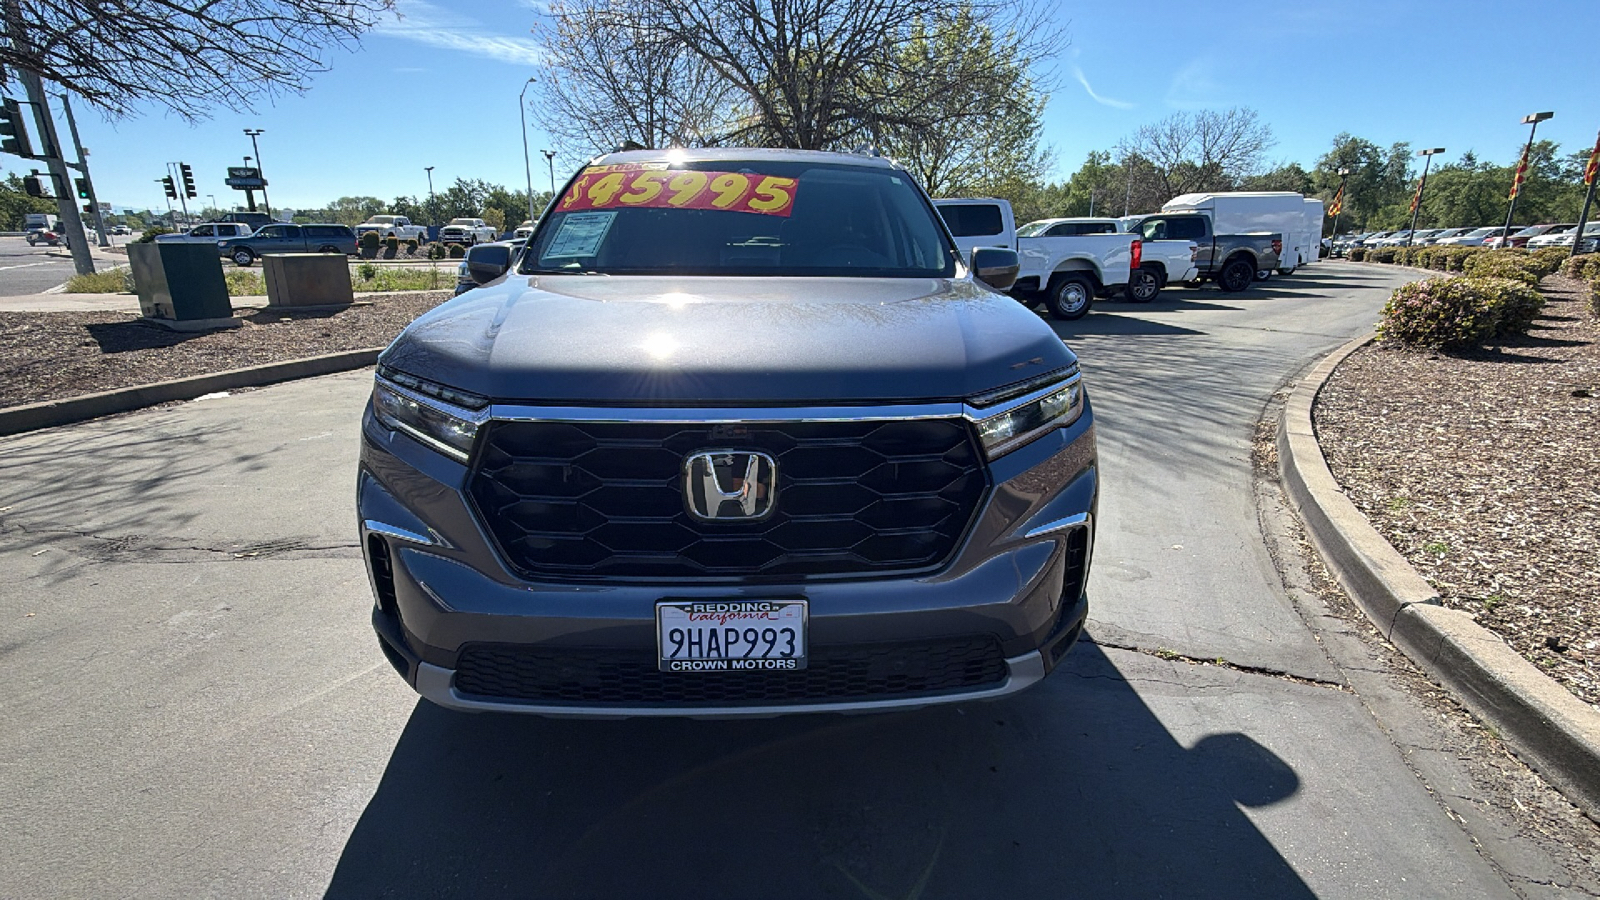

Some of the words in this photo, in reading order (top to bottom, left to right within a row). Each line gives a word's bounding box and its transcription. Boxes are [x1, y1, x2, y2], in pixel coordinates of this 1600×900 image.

[563, 170, 797, 213] $45995
[693, 603, 771, 613] REDDING
[688, 612, 779, 625] California
[669, 628, 796, 658] 9HAP993
[671, 660, 727, 671] CROWN
[732, 659, 796, 670] MOTORS
